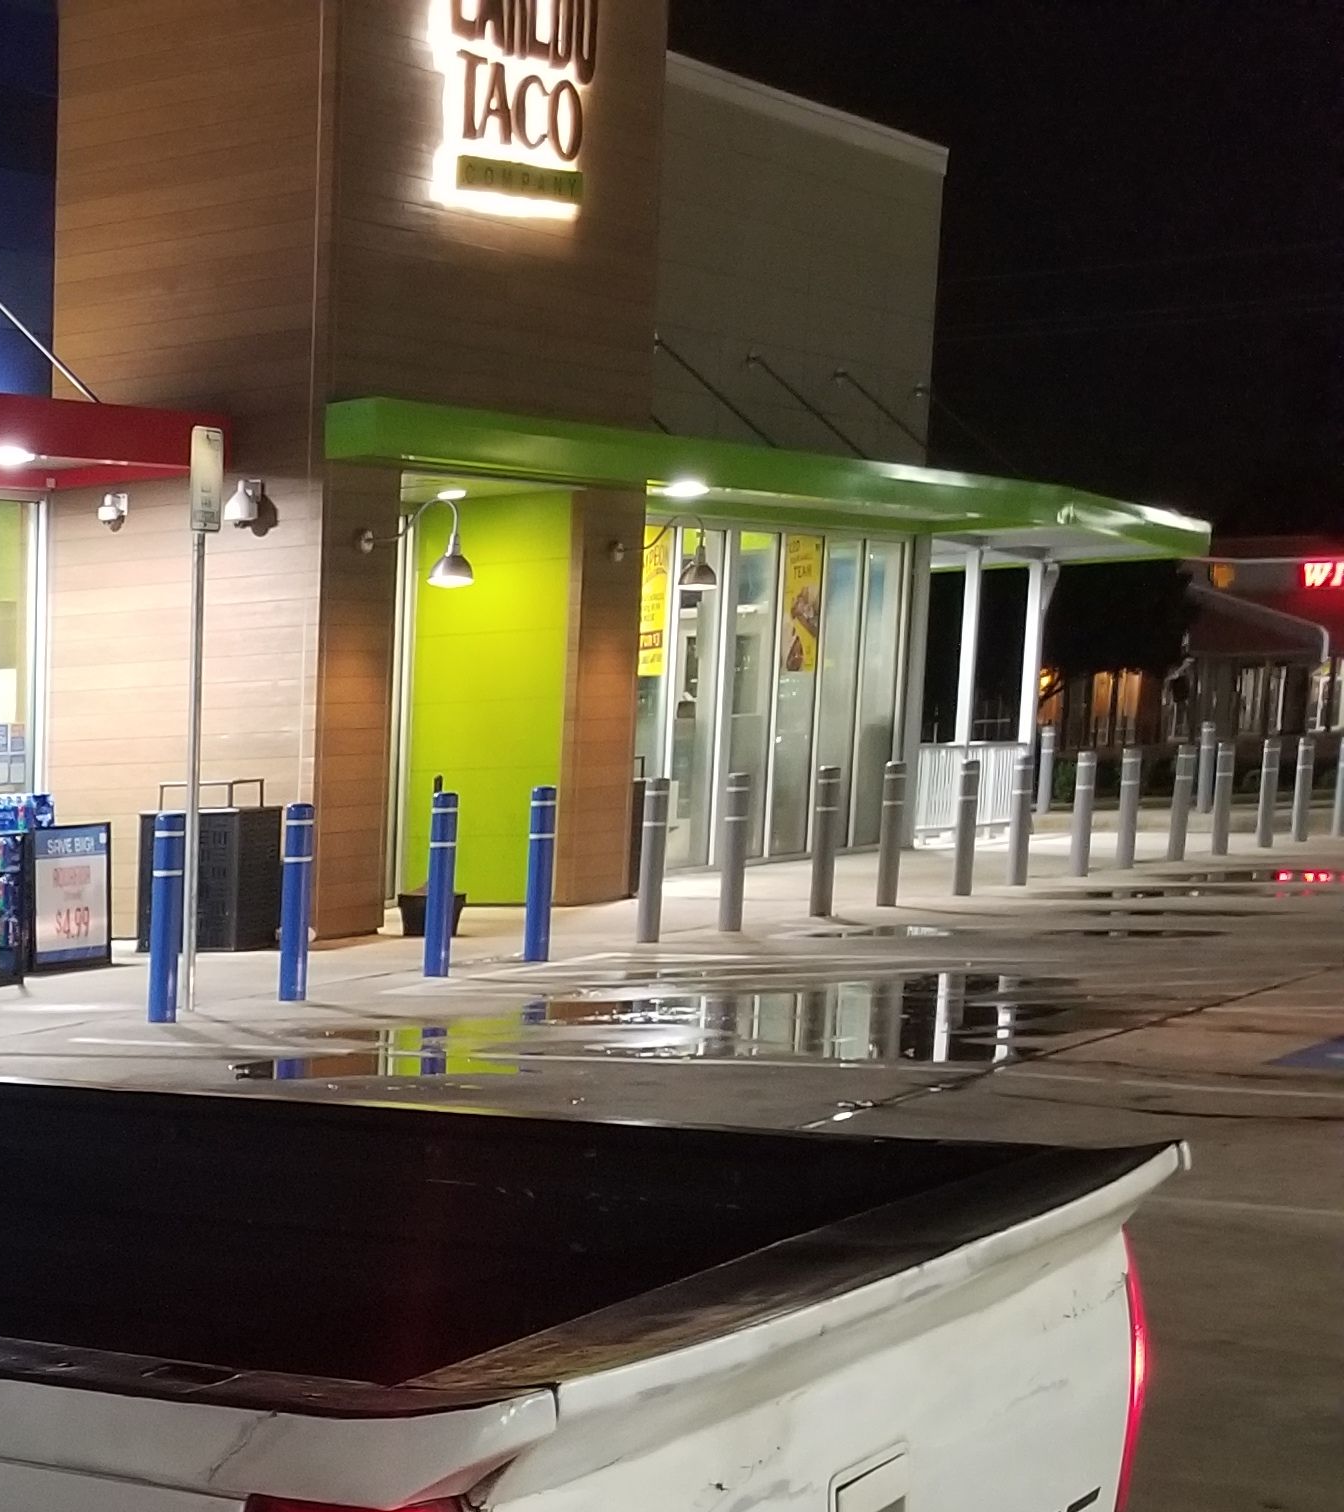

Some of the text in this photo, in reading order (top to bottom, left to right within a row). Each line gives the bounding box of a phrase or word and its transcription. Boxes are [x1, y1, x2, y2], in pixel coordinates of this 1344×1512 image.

[456, 48, 583, 162] TACO
[462, 163, 578, 199] COMPANY
[47, 839, 73, 855] SAVE
[55, 906, 90, 939] $4.99
